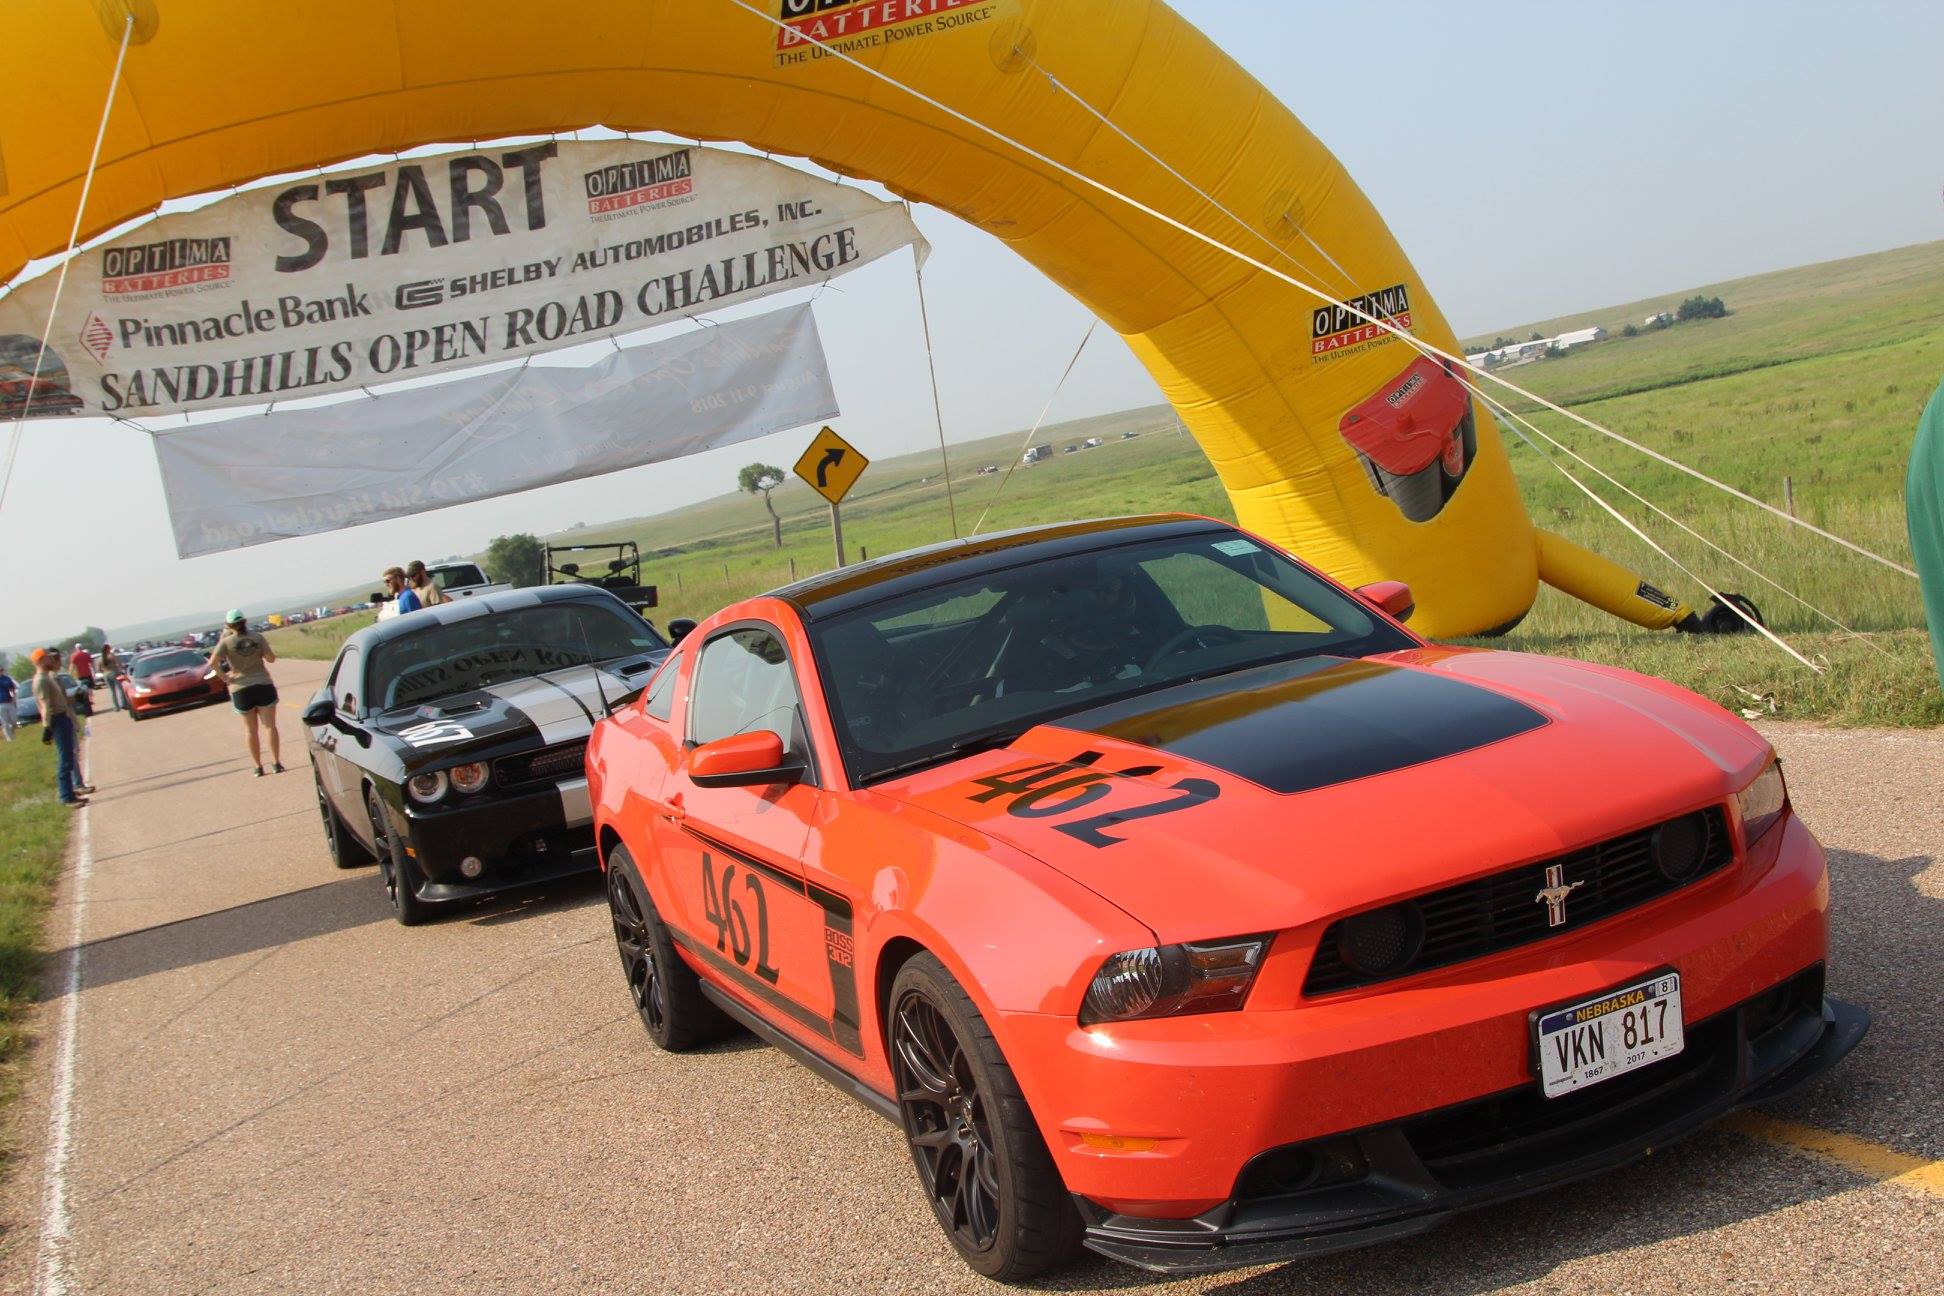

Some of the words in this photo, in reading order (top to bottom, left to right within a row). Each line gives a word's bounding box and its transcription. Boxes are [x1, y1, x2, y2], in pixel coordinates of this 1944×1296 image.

[776, 52, 807, 65] THE
[884, 22, 933, 42] POWER
[936, 8, 991, 31] SOURCE
[587, 153, 690, 196] OPTIMA
[272, 143, 558, 272] START
[590, 181, 691, 213] BATTERIES
[639, 202, 666, 214] POWER
[106, 239, 228, 276] OPTIMA
[450, 255, 561, 298] SHELBY
[571, 208, 768, 273] AUTOMOBILES,
[778, 199, 822, 221] INC.
[105, 266, 229, 292] BATTERIES
[100, 340, 354, 413] SANDHILLS
[368, 316, 491, 374] OPEN
[502, 289, 623, 350] ROAD
[637, 227, 860, 316] CHALLENGE
[1315, 288, 1408, 335] OPTIMA
[1313, 355, 1330, 364] THE
[1331, 346, 1367, 359] ULTIMATE
[1368, 337, 1391, 349] POWER
[965, 750, 1220, 848] 462
[702, 852, 780, 985] 462
[826, 928, 853, 952] BOSS
[829, 946, 852, 968] 302
[1576, 990, 1645, 1022] NEBRASKA
[1661, 981, 1668, 993] 8
[1555, 1021, 1605, 1073] VKN
[1623, 999, 1667, 1050] 817
[1585, 1066, 1603, 1079] 1867
[1626, 1052, 1646, 1065] 2017
